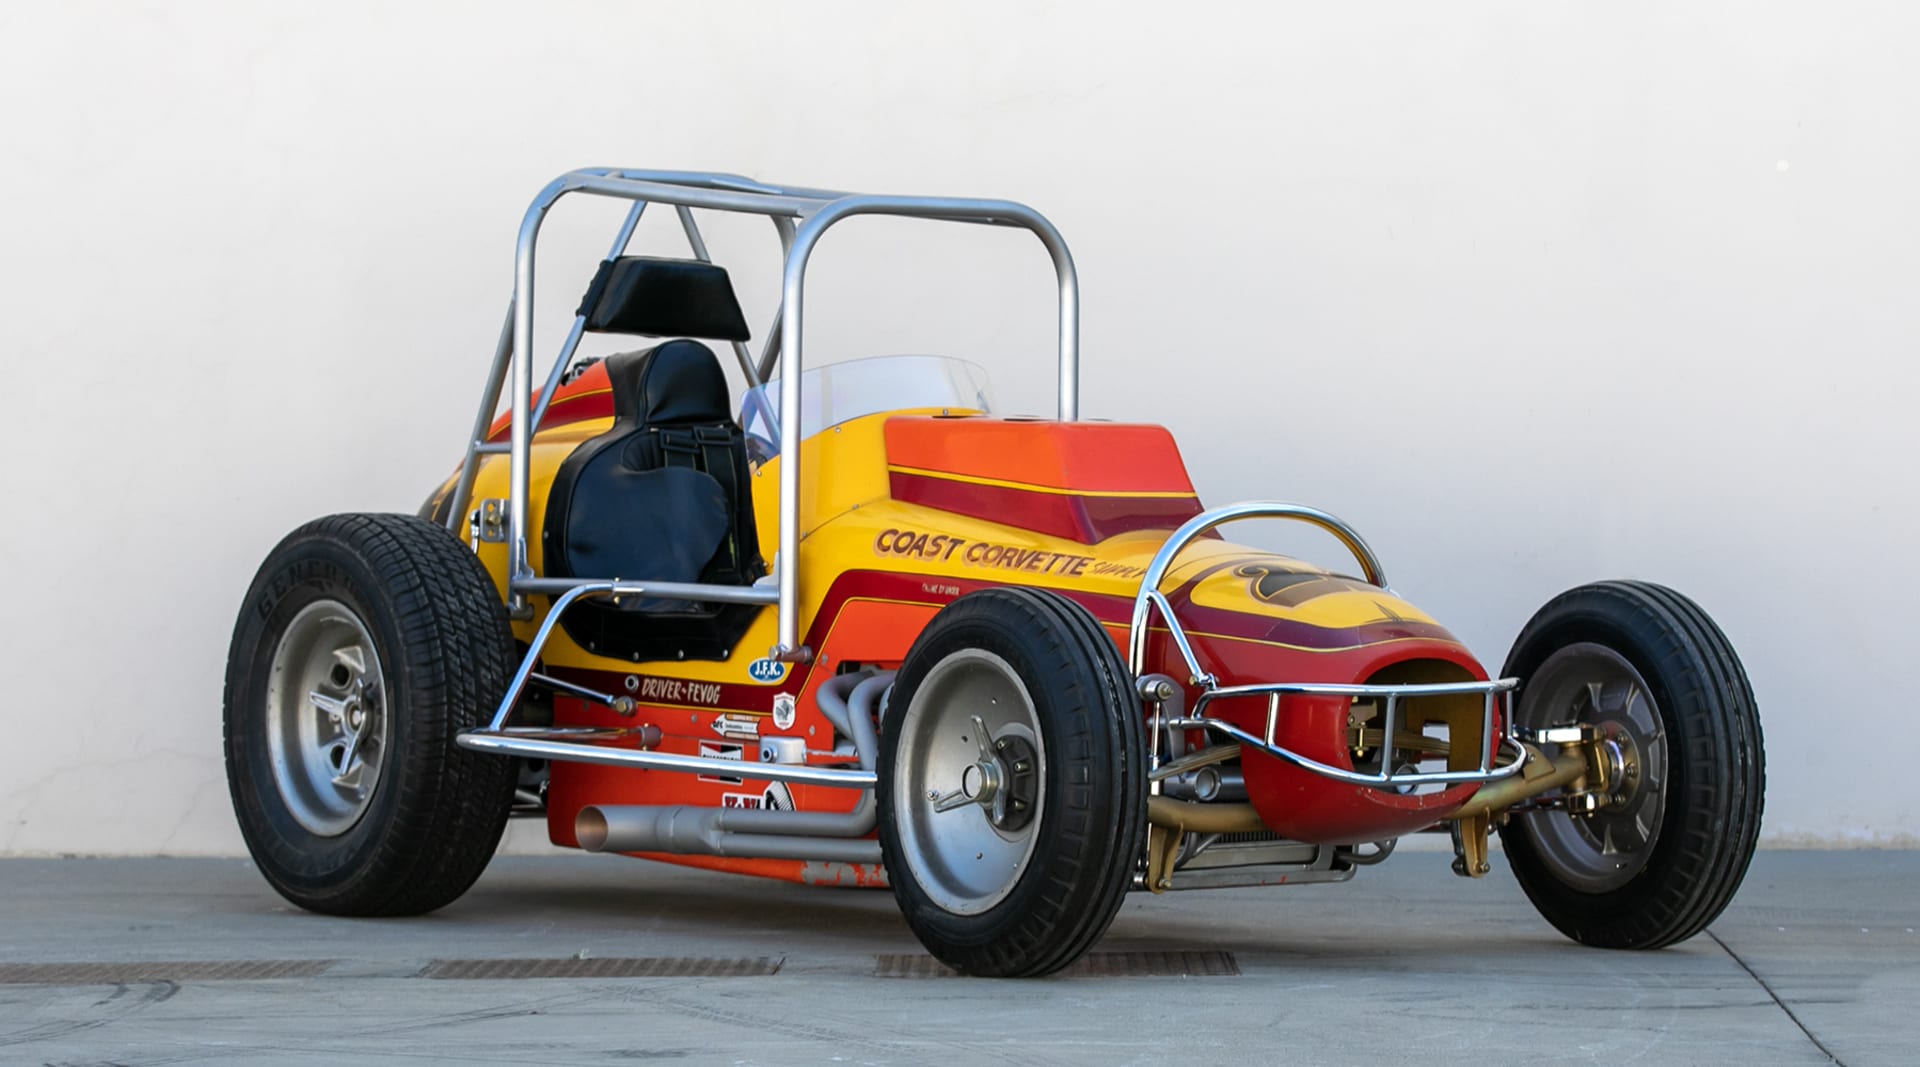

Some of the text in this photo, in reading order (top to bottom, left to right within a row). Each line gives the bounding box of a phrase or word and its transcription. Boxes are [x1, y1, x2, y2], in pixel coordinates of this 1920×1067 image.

[875, 529, 966, 562] COAST
[964, 543, 1096, 577] CORVETTE
[755, 661, 781, 675] J.F.K.
